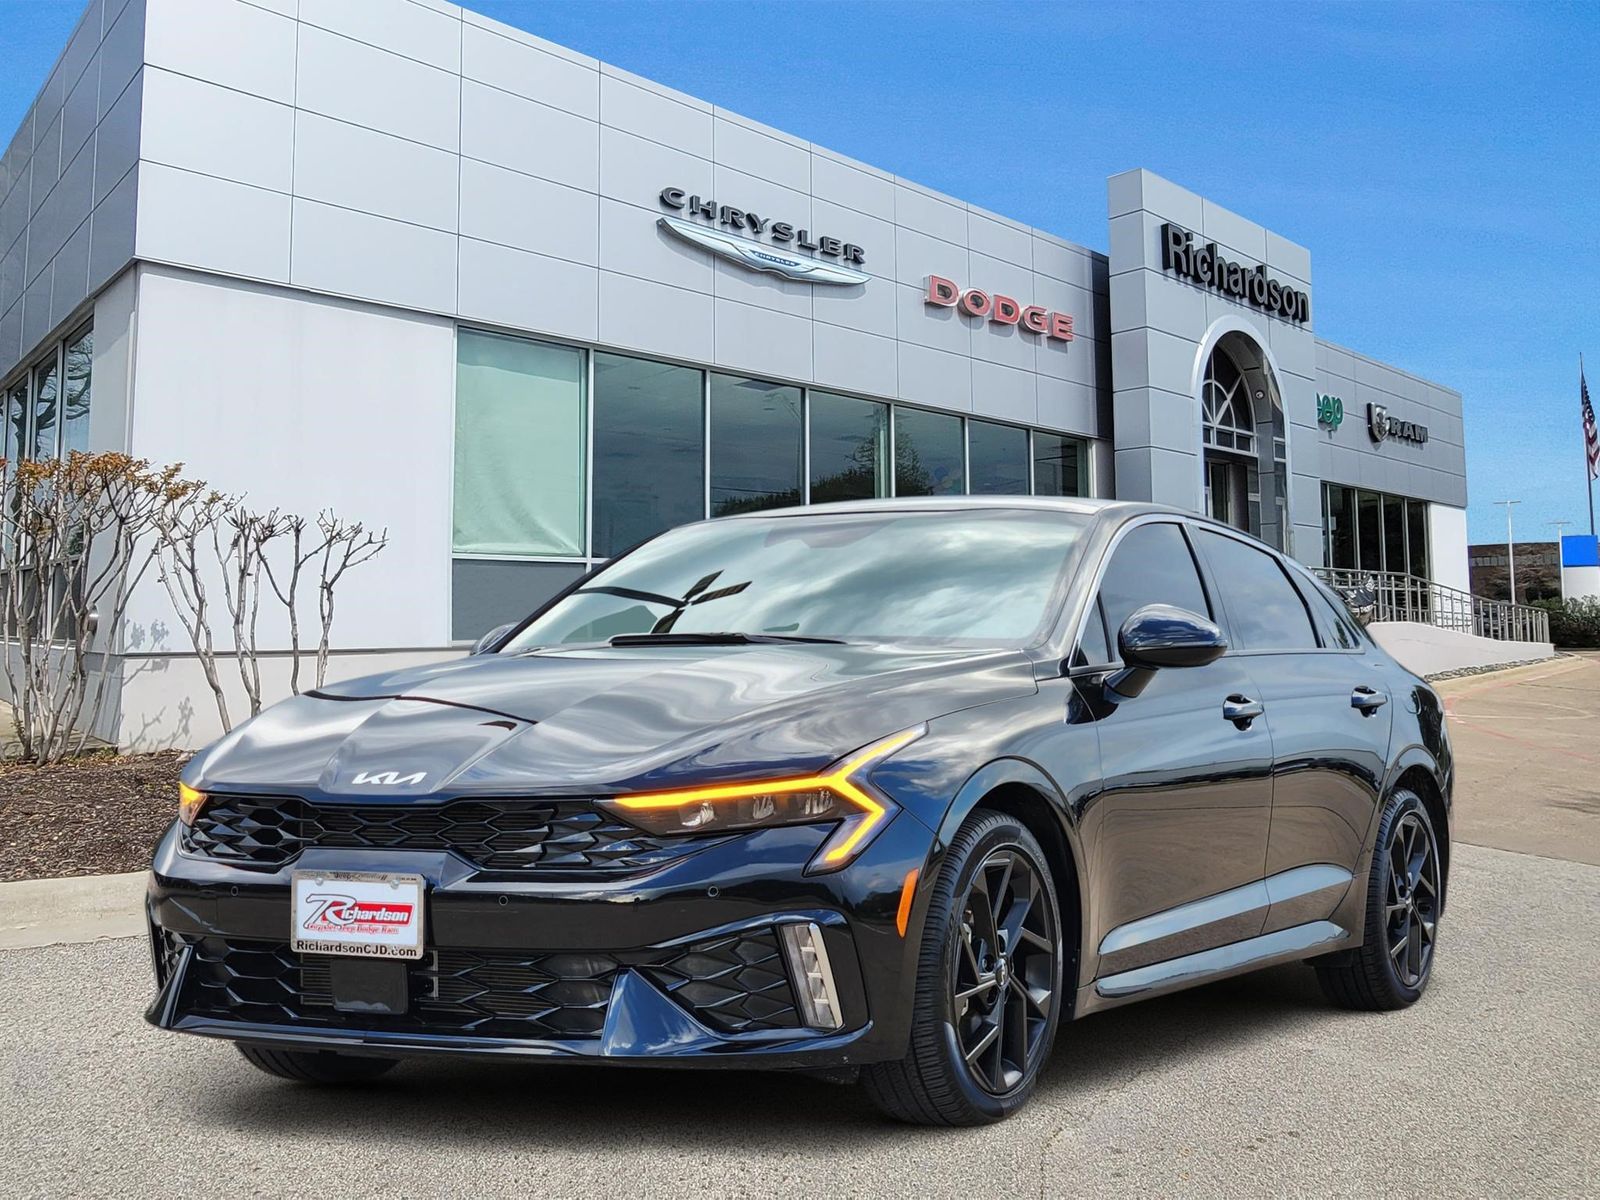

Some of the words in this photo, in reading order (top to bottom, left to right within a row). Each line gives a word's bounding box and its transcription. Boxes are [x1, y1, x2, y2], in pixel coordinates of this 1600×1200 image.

[659, 187, 866, 264] CHRYSLER
[1161, 223, 1309, 323] Richardson
[924, 274, 1074, 342] DODGE
[1316, 392, 1343, 432] ep
[1388, 416, 1428, 443] RAM
[303, 893, 410, 929] Richardson
[296, 940, 417, 957] RichardsonCJD.com
